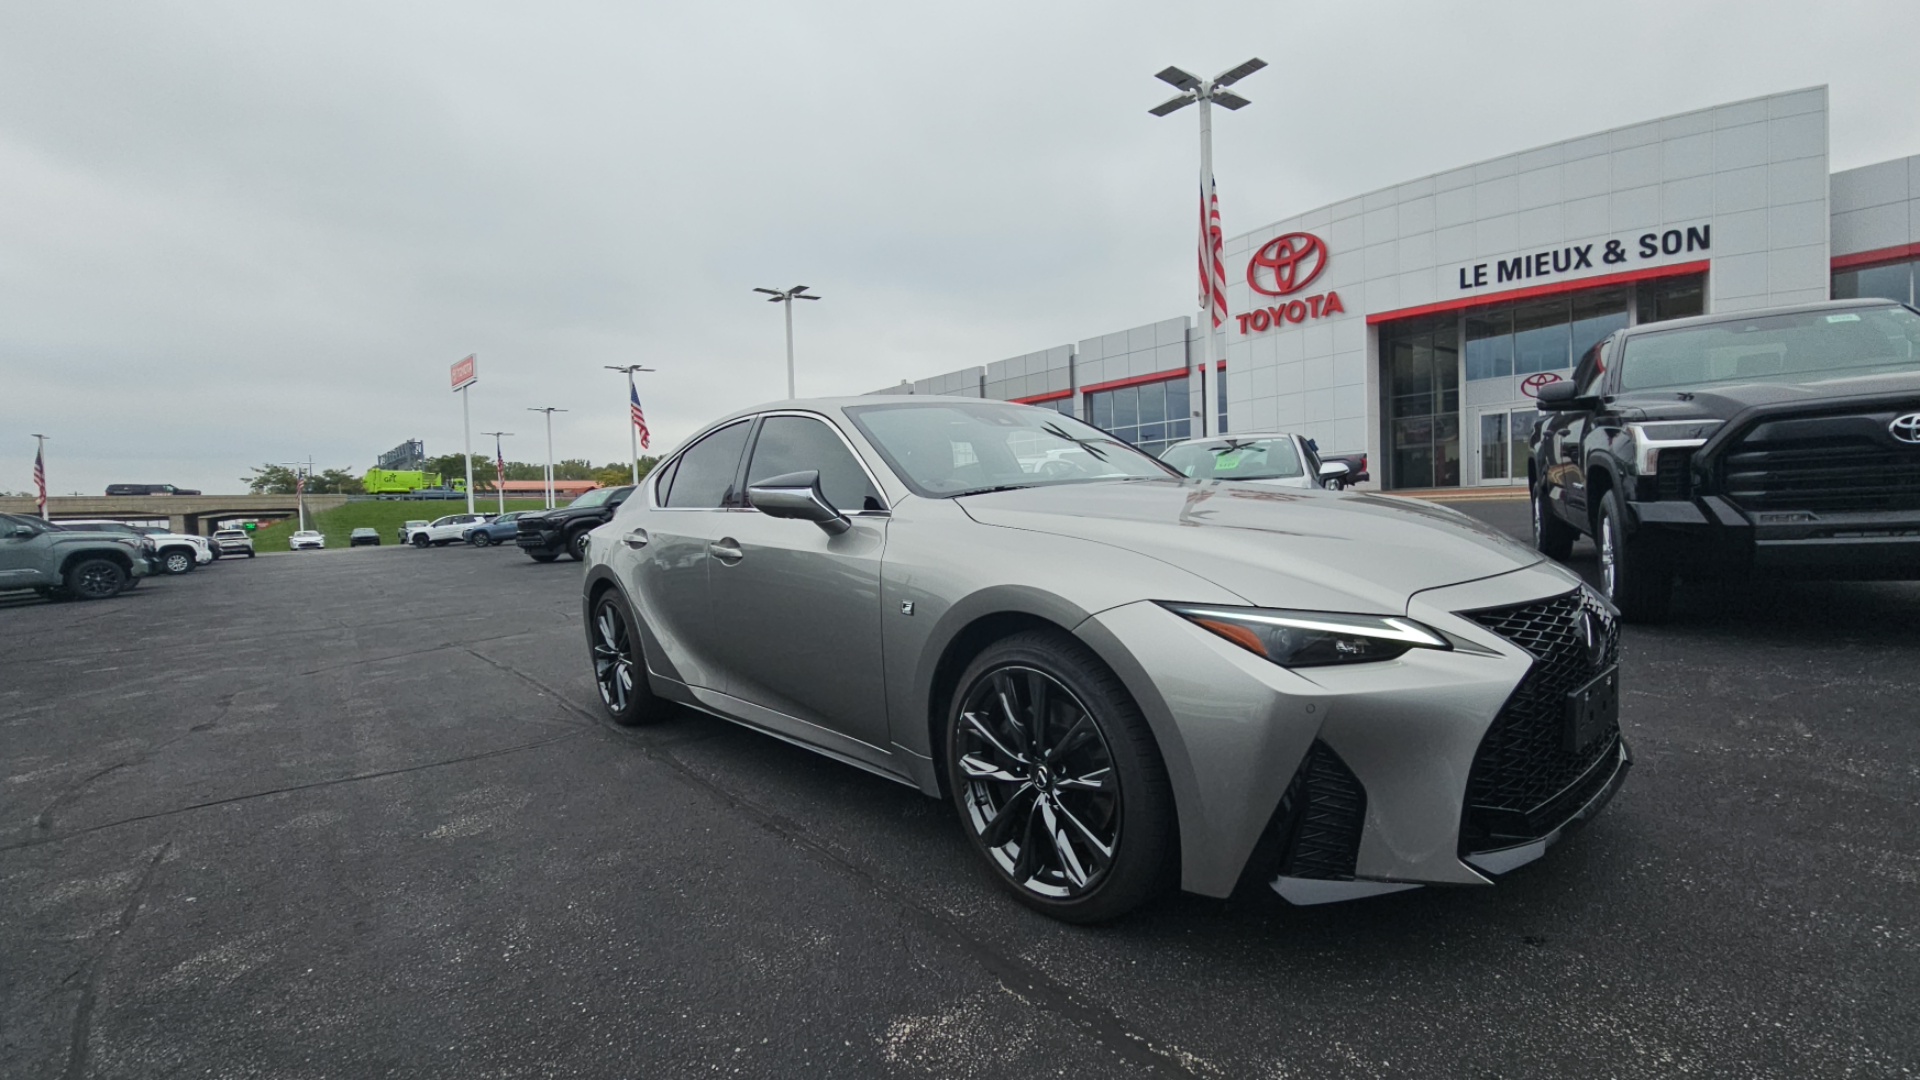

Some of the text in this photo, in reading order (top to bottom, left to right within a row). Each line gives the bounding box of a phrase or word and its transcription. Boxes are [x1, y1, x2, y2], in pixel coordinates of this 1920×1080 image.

[1459, 224, 1710, 289] LE MIEUX & SON
[1236, 291, 1344, 335] TOYOTA
